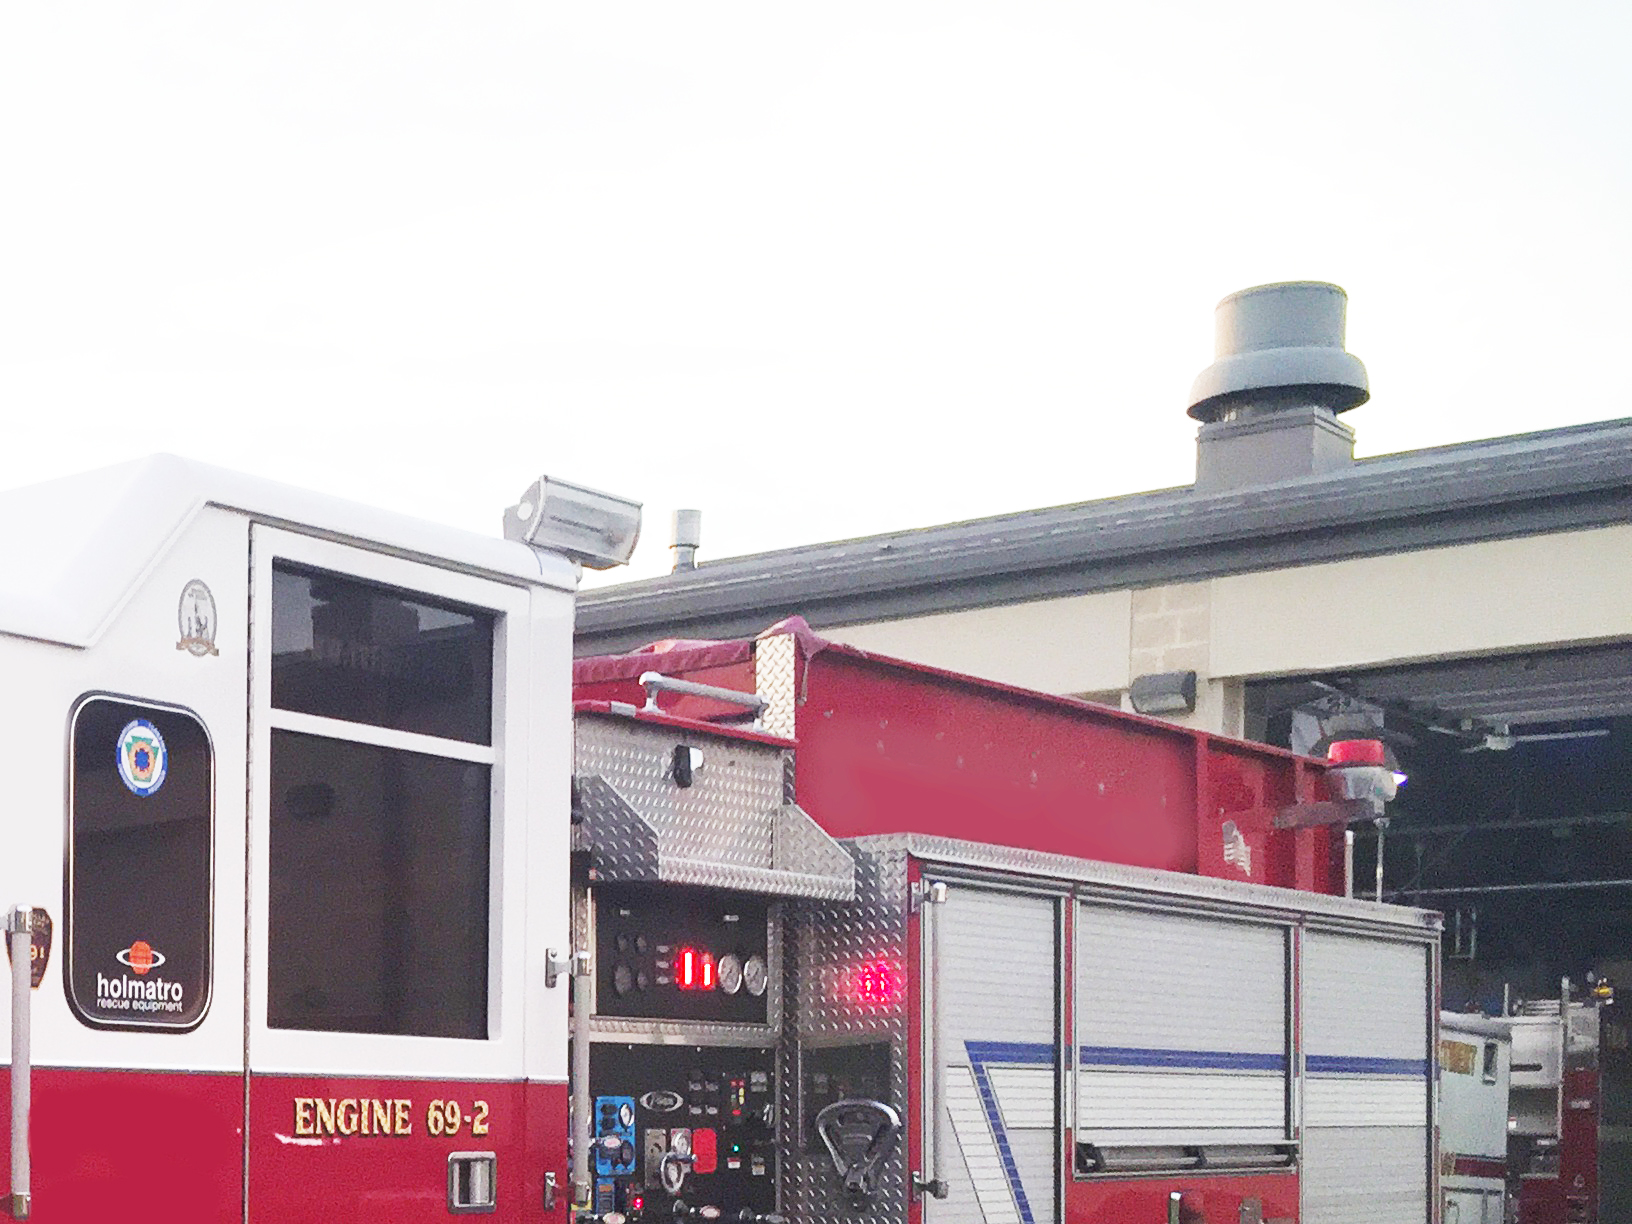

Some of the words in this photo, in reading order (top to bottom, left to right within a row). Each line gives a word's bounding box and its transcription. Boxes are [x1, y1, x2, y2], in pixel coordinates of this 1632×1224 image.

[97, 972, 183, 1001] holmatro
[97, 998, 130, 1009] rescue
[132, 1000, 183, 1012] equipment
[294, 1098, 412, 1136] ENGINE
[426, 1099, 489, 1136] 69-2
